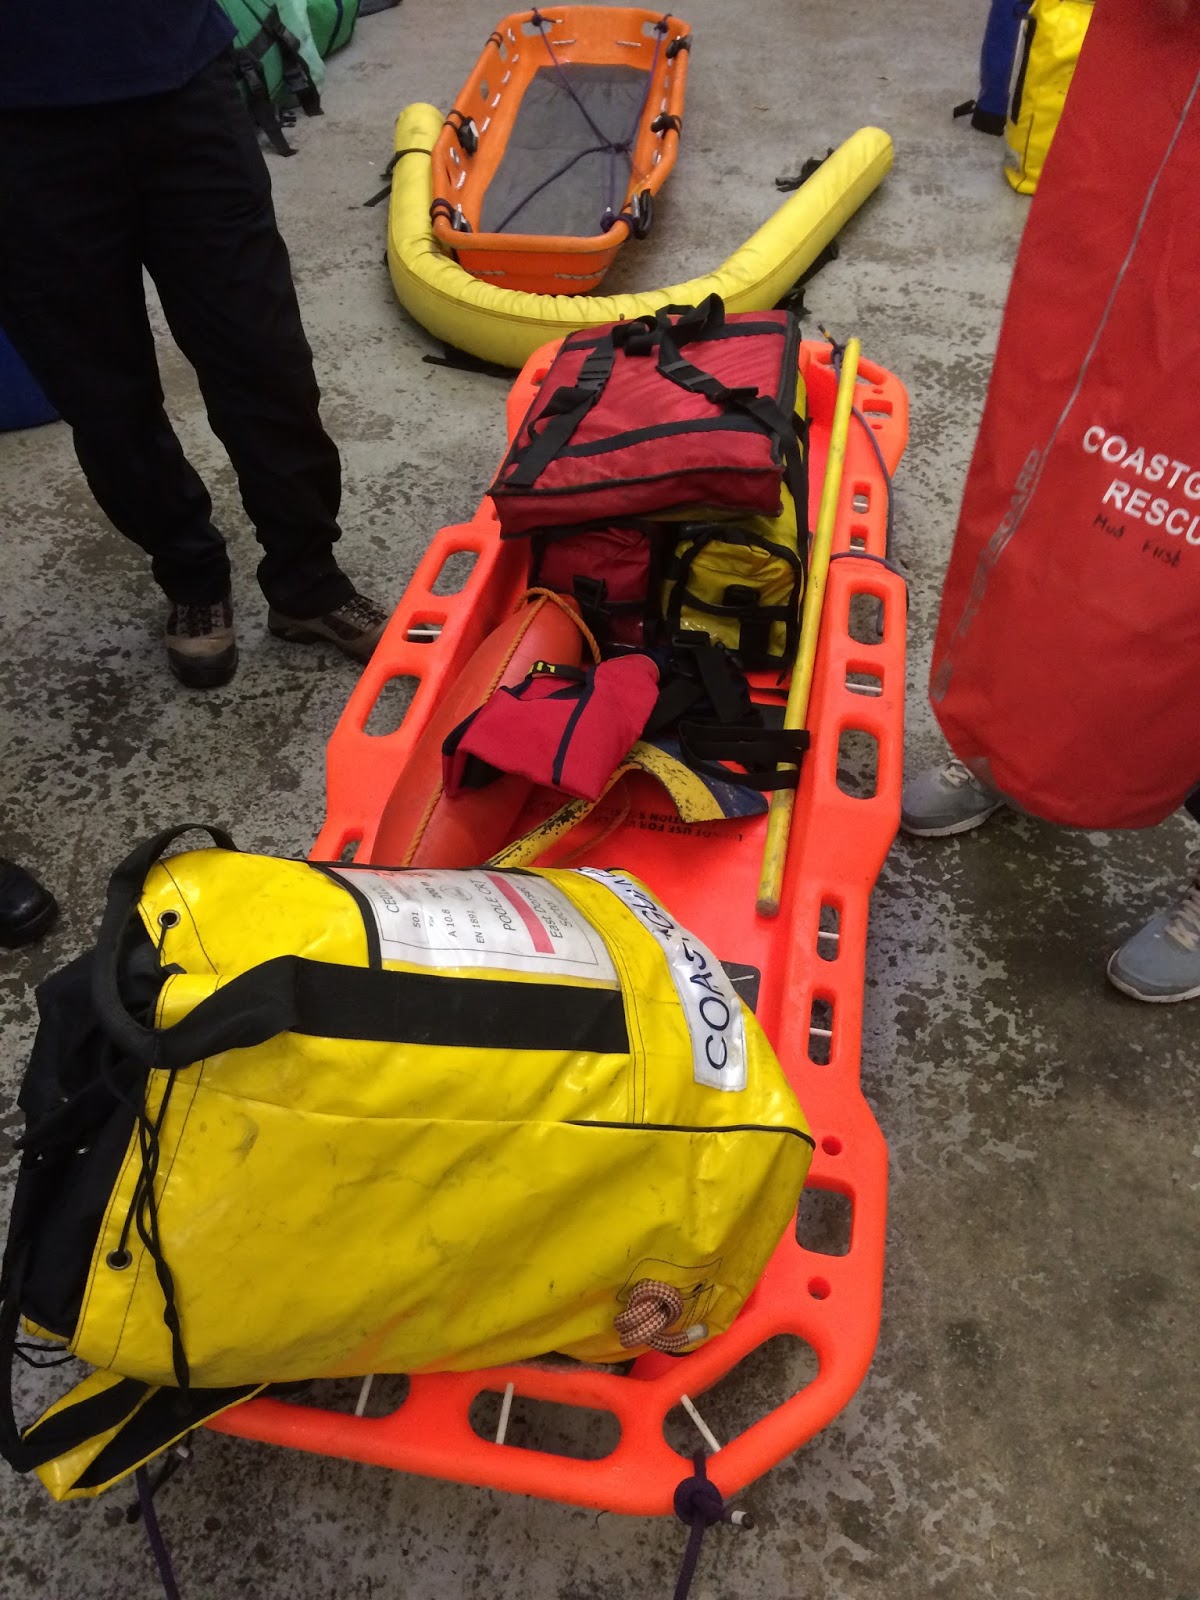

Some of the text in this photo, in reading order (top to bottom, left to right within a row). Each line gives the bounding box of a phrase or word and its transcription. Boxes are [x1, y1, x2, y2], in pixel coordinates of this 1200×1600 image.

[411, 912, 421, 929] 501
[441, 908, 456, 928] 10.8
[485, 895, 517, 932] POOLE
[541, 914, 564, 939] East
[474, 931, 485, 944] EN
